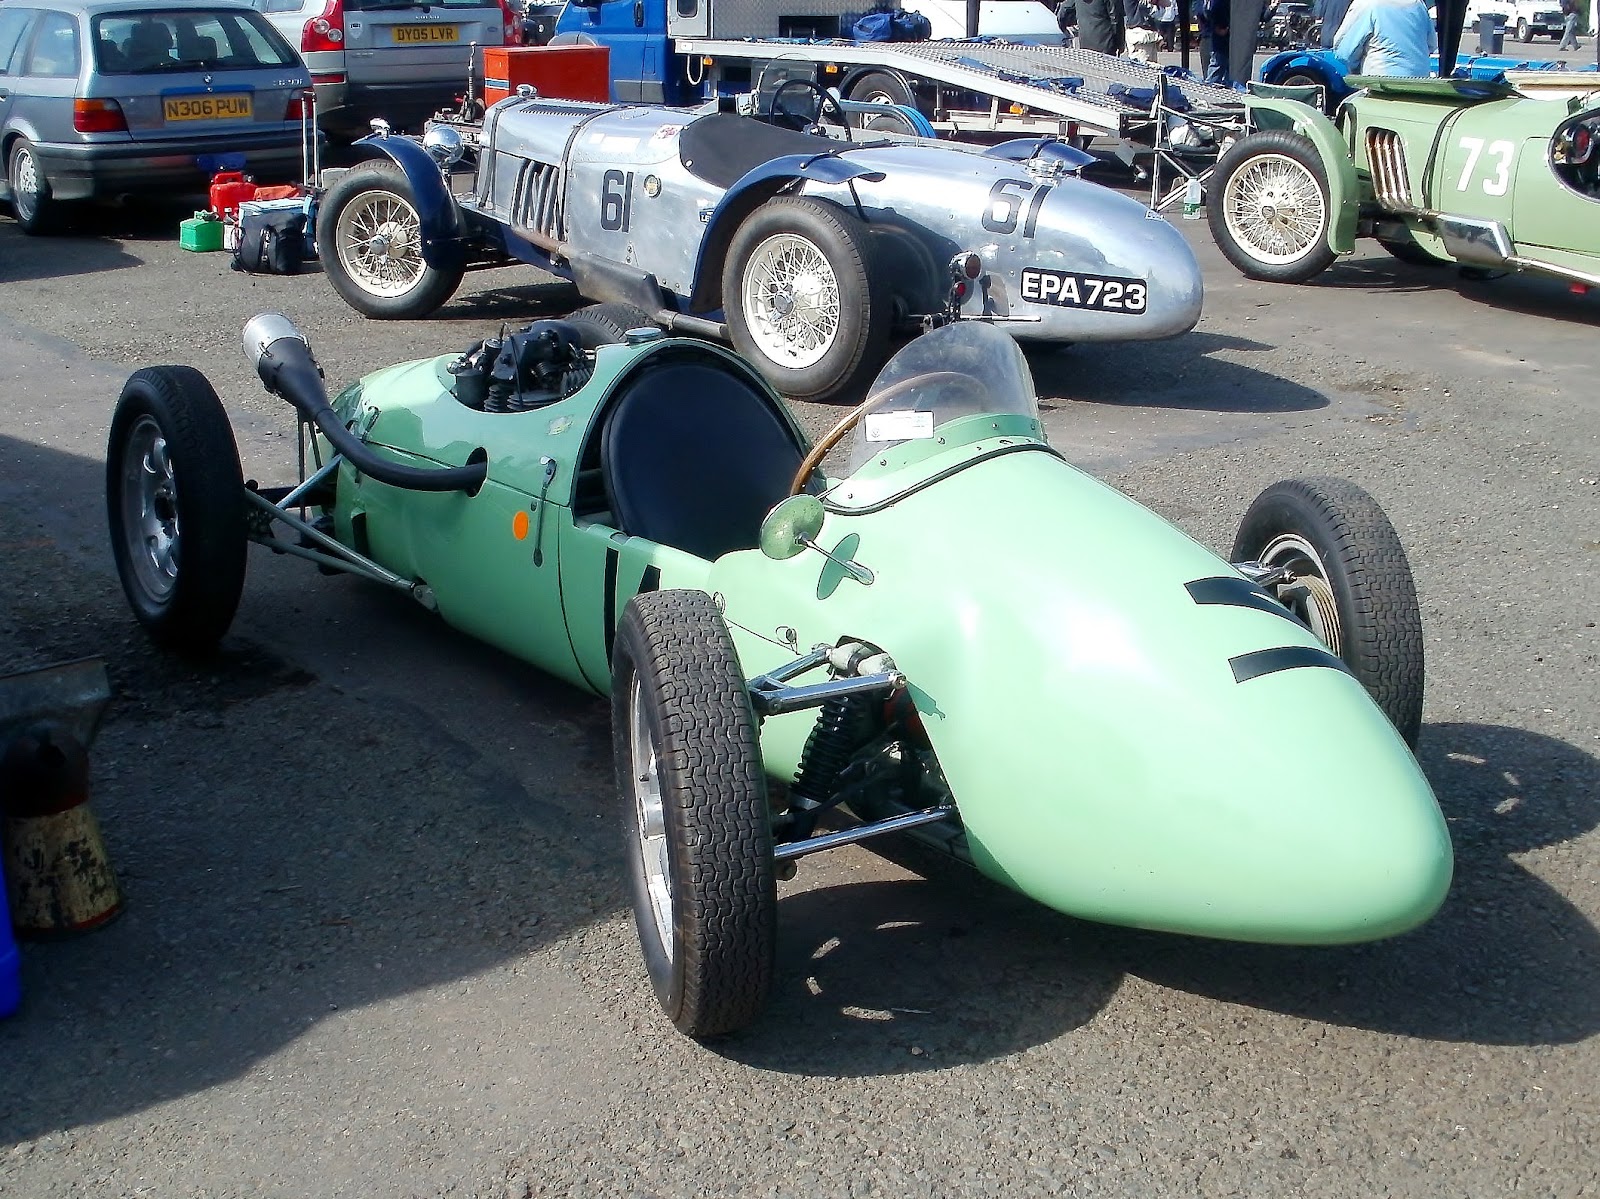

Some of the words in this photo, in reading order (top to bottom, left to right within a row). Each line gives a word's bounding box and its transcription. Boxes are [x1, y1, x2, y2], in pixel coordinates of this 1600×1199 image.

[397, 28, 428, 41] DY05
[431, 28, 453, 40] LVR
[168, 101, 213, 117] N306
[216, 99, 248, 114] PUW
[1457, 136, 1515, 197] 73
[600, 169, 634, 233] 61
[981, 178, 1054, 239] 61
[1022, 271, 1081, 304] EPA
[1084, 278, 1146, 311] 723
